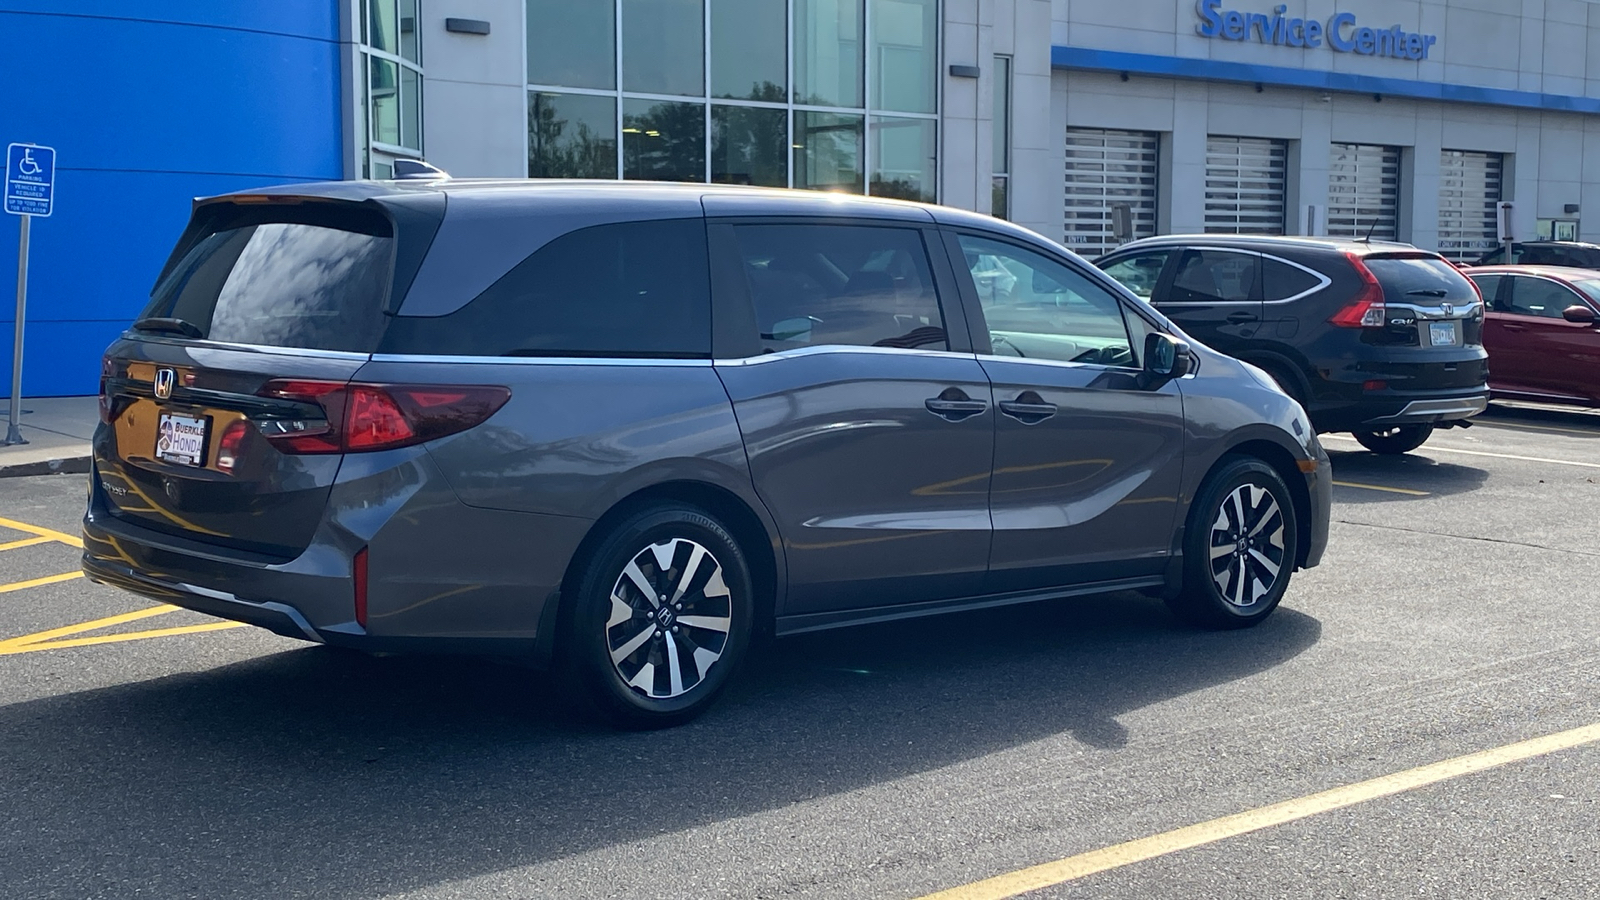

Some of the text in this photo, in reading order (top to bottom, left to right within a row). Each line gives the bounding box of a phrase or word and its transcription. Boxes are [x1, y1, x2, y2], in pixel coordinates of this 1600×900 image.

[1197, 0, 1437, 60] Service Center
[175, 422, 204, 436] BUERKLE
[172, 433, 201, 453] HONDA
